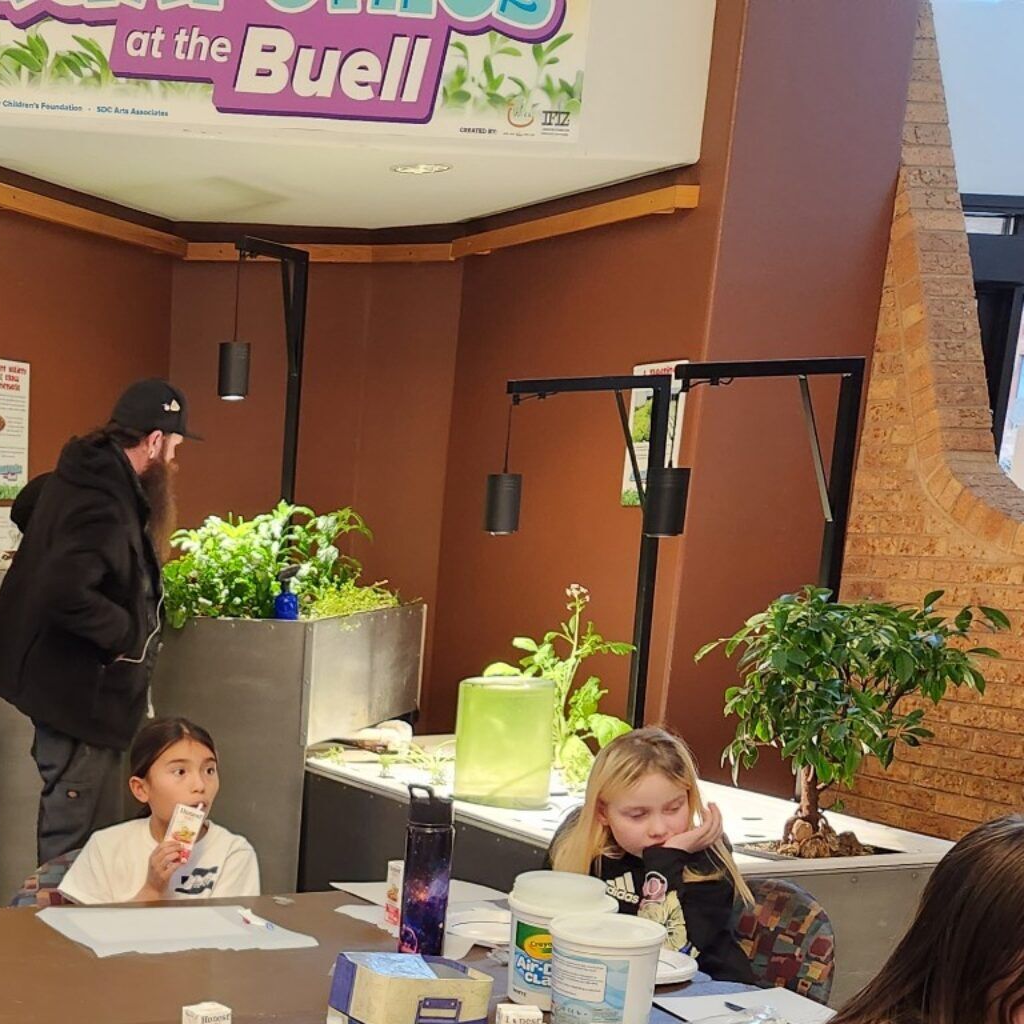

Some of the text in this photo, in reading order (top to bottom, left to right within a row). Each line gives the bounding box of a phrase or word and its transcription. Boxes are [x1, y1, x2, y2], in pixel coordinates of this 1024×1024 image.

[126, 25, 433, 103] at the Buell
[2, 99, 40, 110] Children's
[40, 102, 83, 112] Foundation
[114, 106, 129, 115] Arts
[130, 107, 169, 117] Associates
[607, 884, 640, 904] didas
[530, 940, 553, 949] Crayo
[517, 956, 553, 976] Air-D
[525, 971, 553, 987] CLa
[506, 1016, 542, 1024] nest
